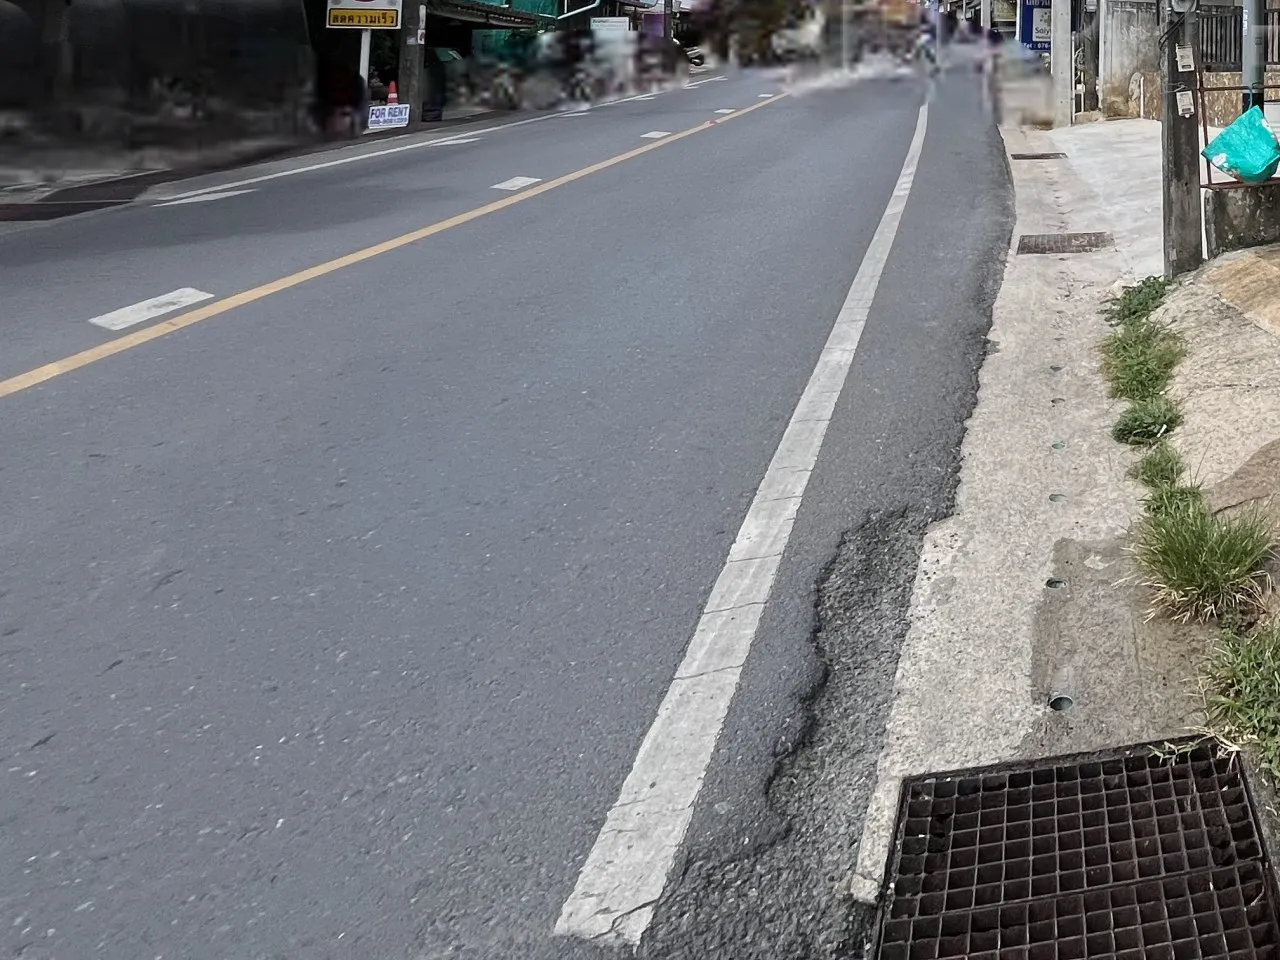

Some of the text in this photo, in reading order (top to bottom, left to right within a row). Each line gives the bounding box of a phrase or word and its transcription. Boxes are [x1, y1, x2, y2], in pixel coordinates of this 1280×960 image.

[332, 12, 395, 25] ลดความเร็ว
[370, 106, 408, 119] FOR RENT
